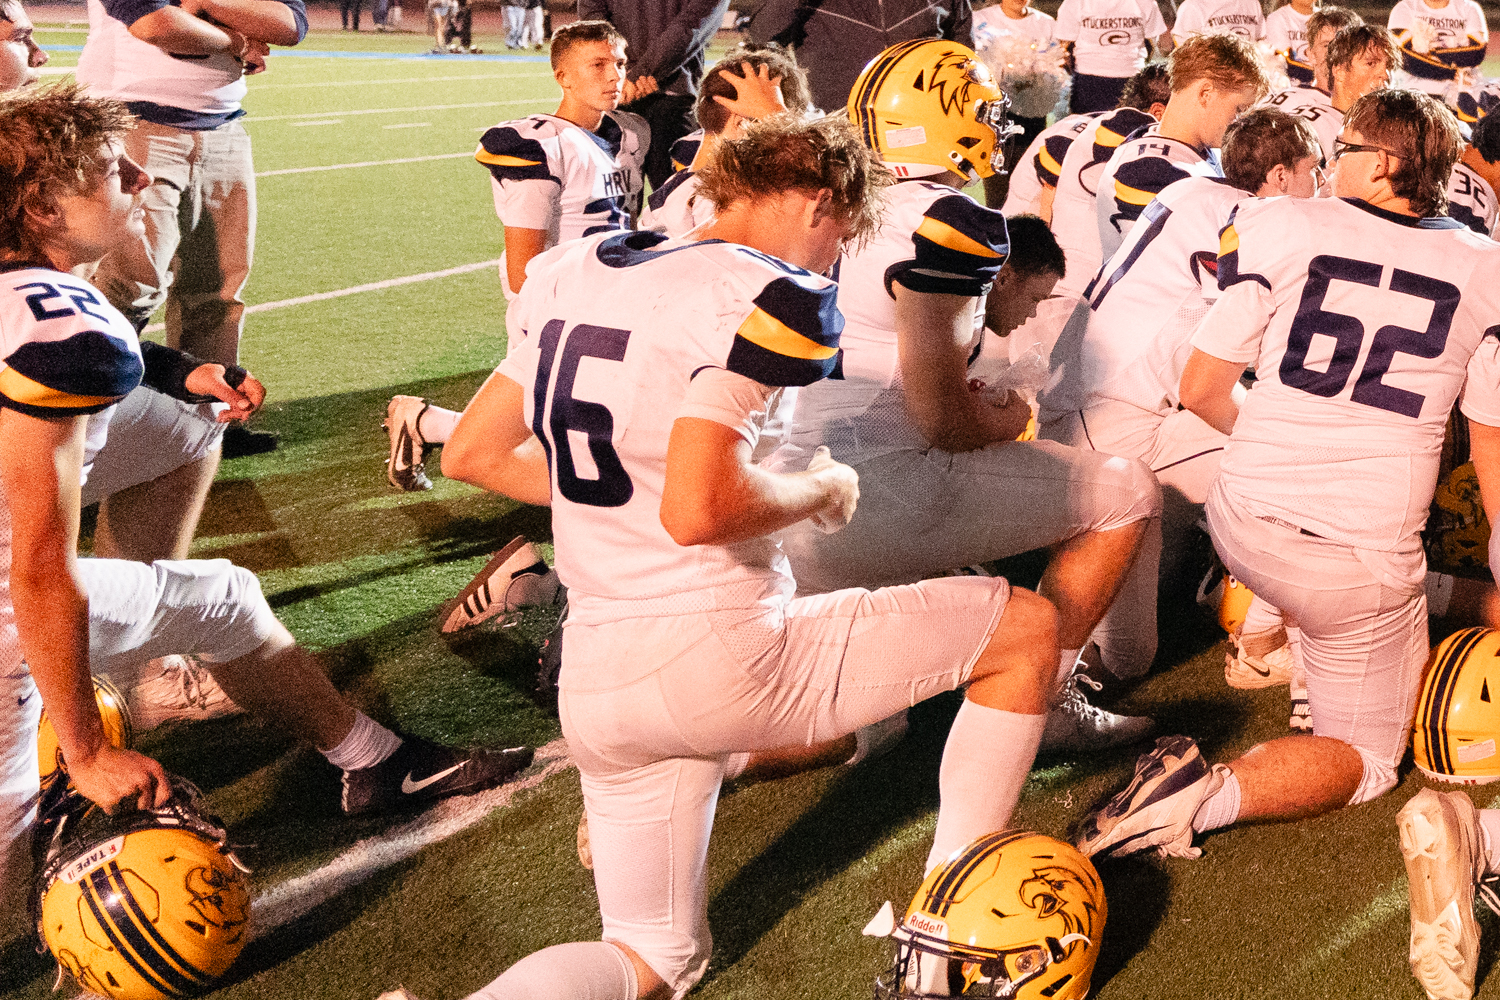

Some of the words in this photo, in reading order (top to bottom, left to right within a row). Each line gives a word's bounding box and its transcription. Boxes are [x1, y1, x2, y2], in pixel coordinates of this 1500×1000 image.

[1137, 143, 1171, 157] 14
[602, 169, 632, 196] HRV
[1454, 169, 1488, 209] 32
[13, 282, 110, 325] 22
[1279, 254, 1461, 420] 62
[532, 318, 634, 508] 16
[76, 850, 106, 872] TAPE
